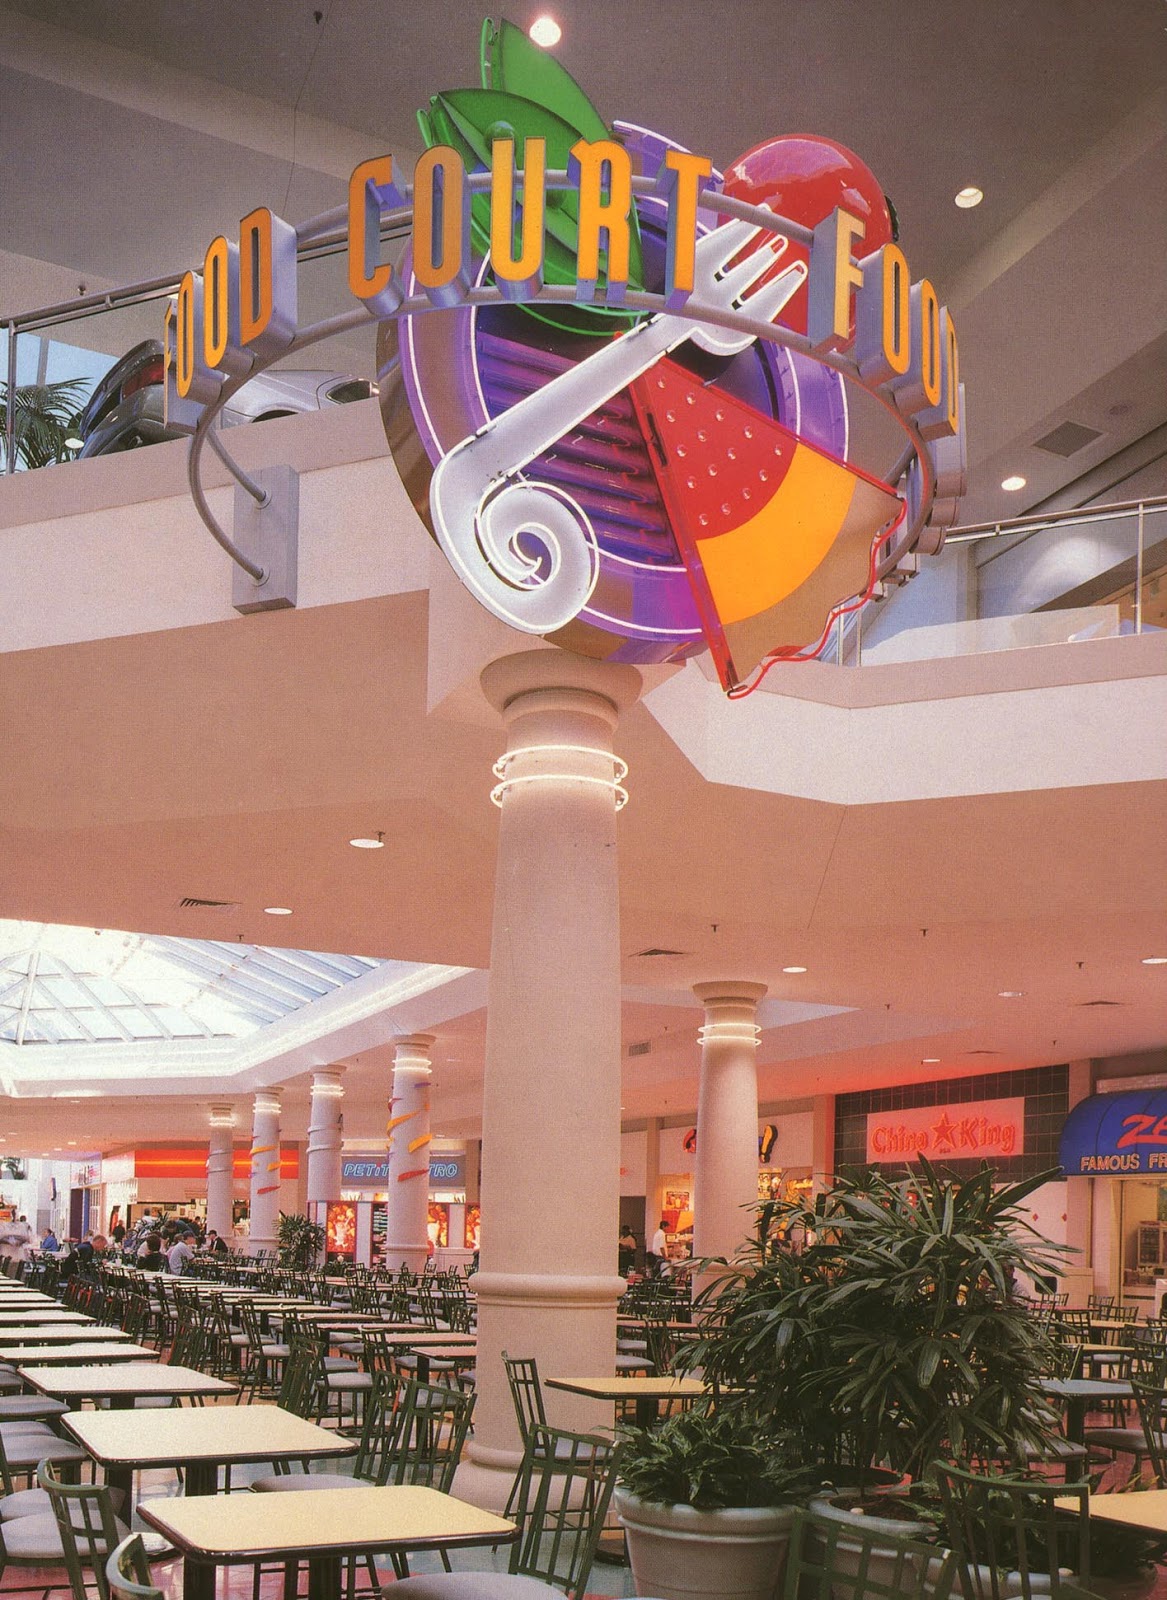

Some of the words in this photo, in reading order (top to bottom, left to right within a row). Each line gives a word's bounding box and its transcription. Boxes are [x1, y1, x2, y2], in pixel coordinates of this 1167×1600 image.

[164, 207, 273, 429] FOOD
[348, 136, 712, 299] COURT
[834, 206, 959, 436] FOOD
[871, 1126, 929, 1154] China
[958, 1117, 1016, 1153] King
[1080, 1153, 1140, 1172] FAMOUS
